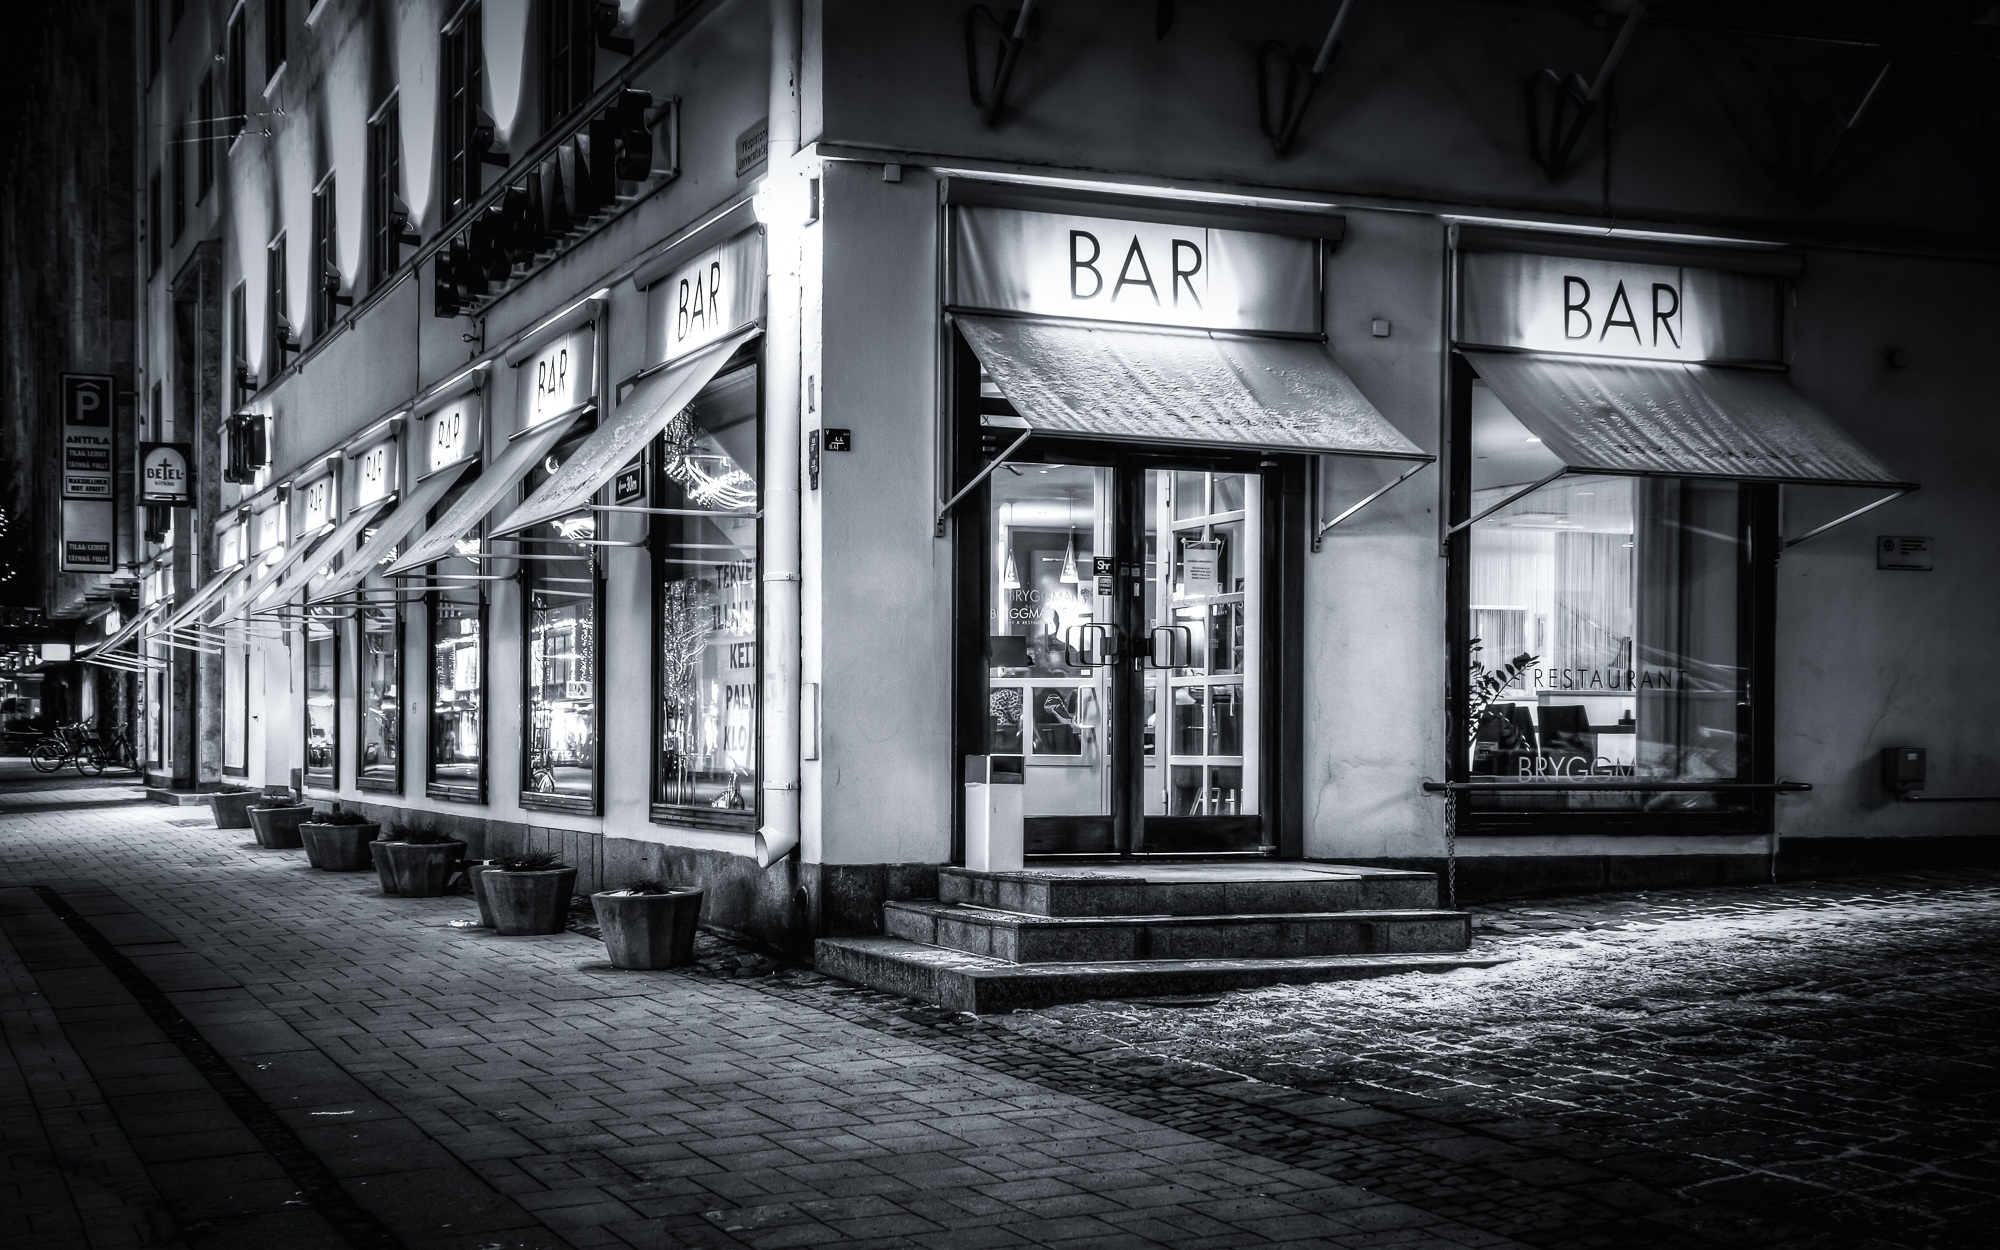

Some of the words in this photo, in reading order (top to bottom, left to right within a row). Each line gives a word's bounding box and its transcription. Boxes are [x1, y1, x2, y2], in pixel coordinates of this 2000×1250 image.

[1069, 229, 1204, 310] BAR
[678, 261, 721, 343] BAR
[1563, 275, 1681, 349] BAR
[538, 348, 567, 413] BAR
[76, 391, 99, 421] P
[66, 435, 110, 445] ANTTILA
[715, 557, 756, 590] TERVE
[1534, 668, 1689, 691] RESTAURANT
[1517, 756, 1640, 784] BRYGGM
